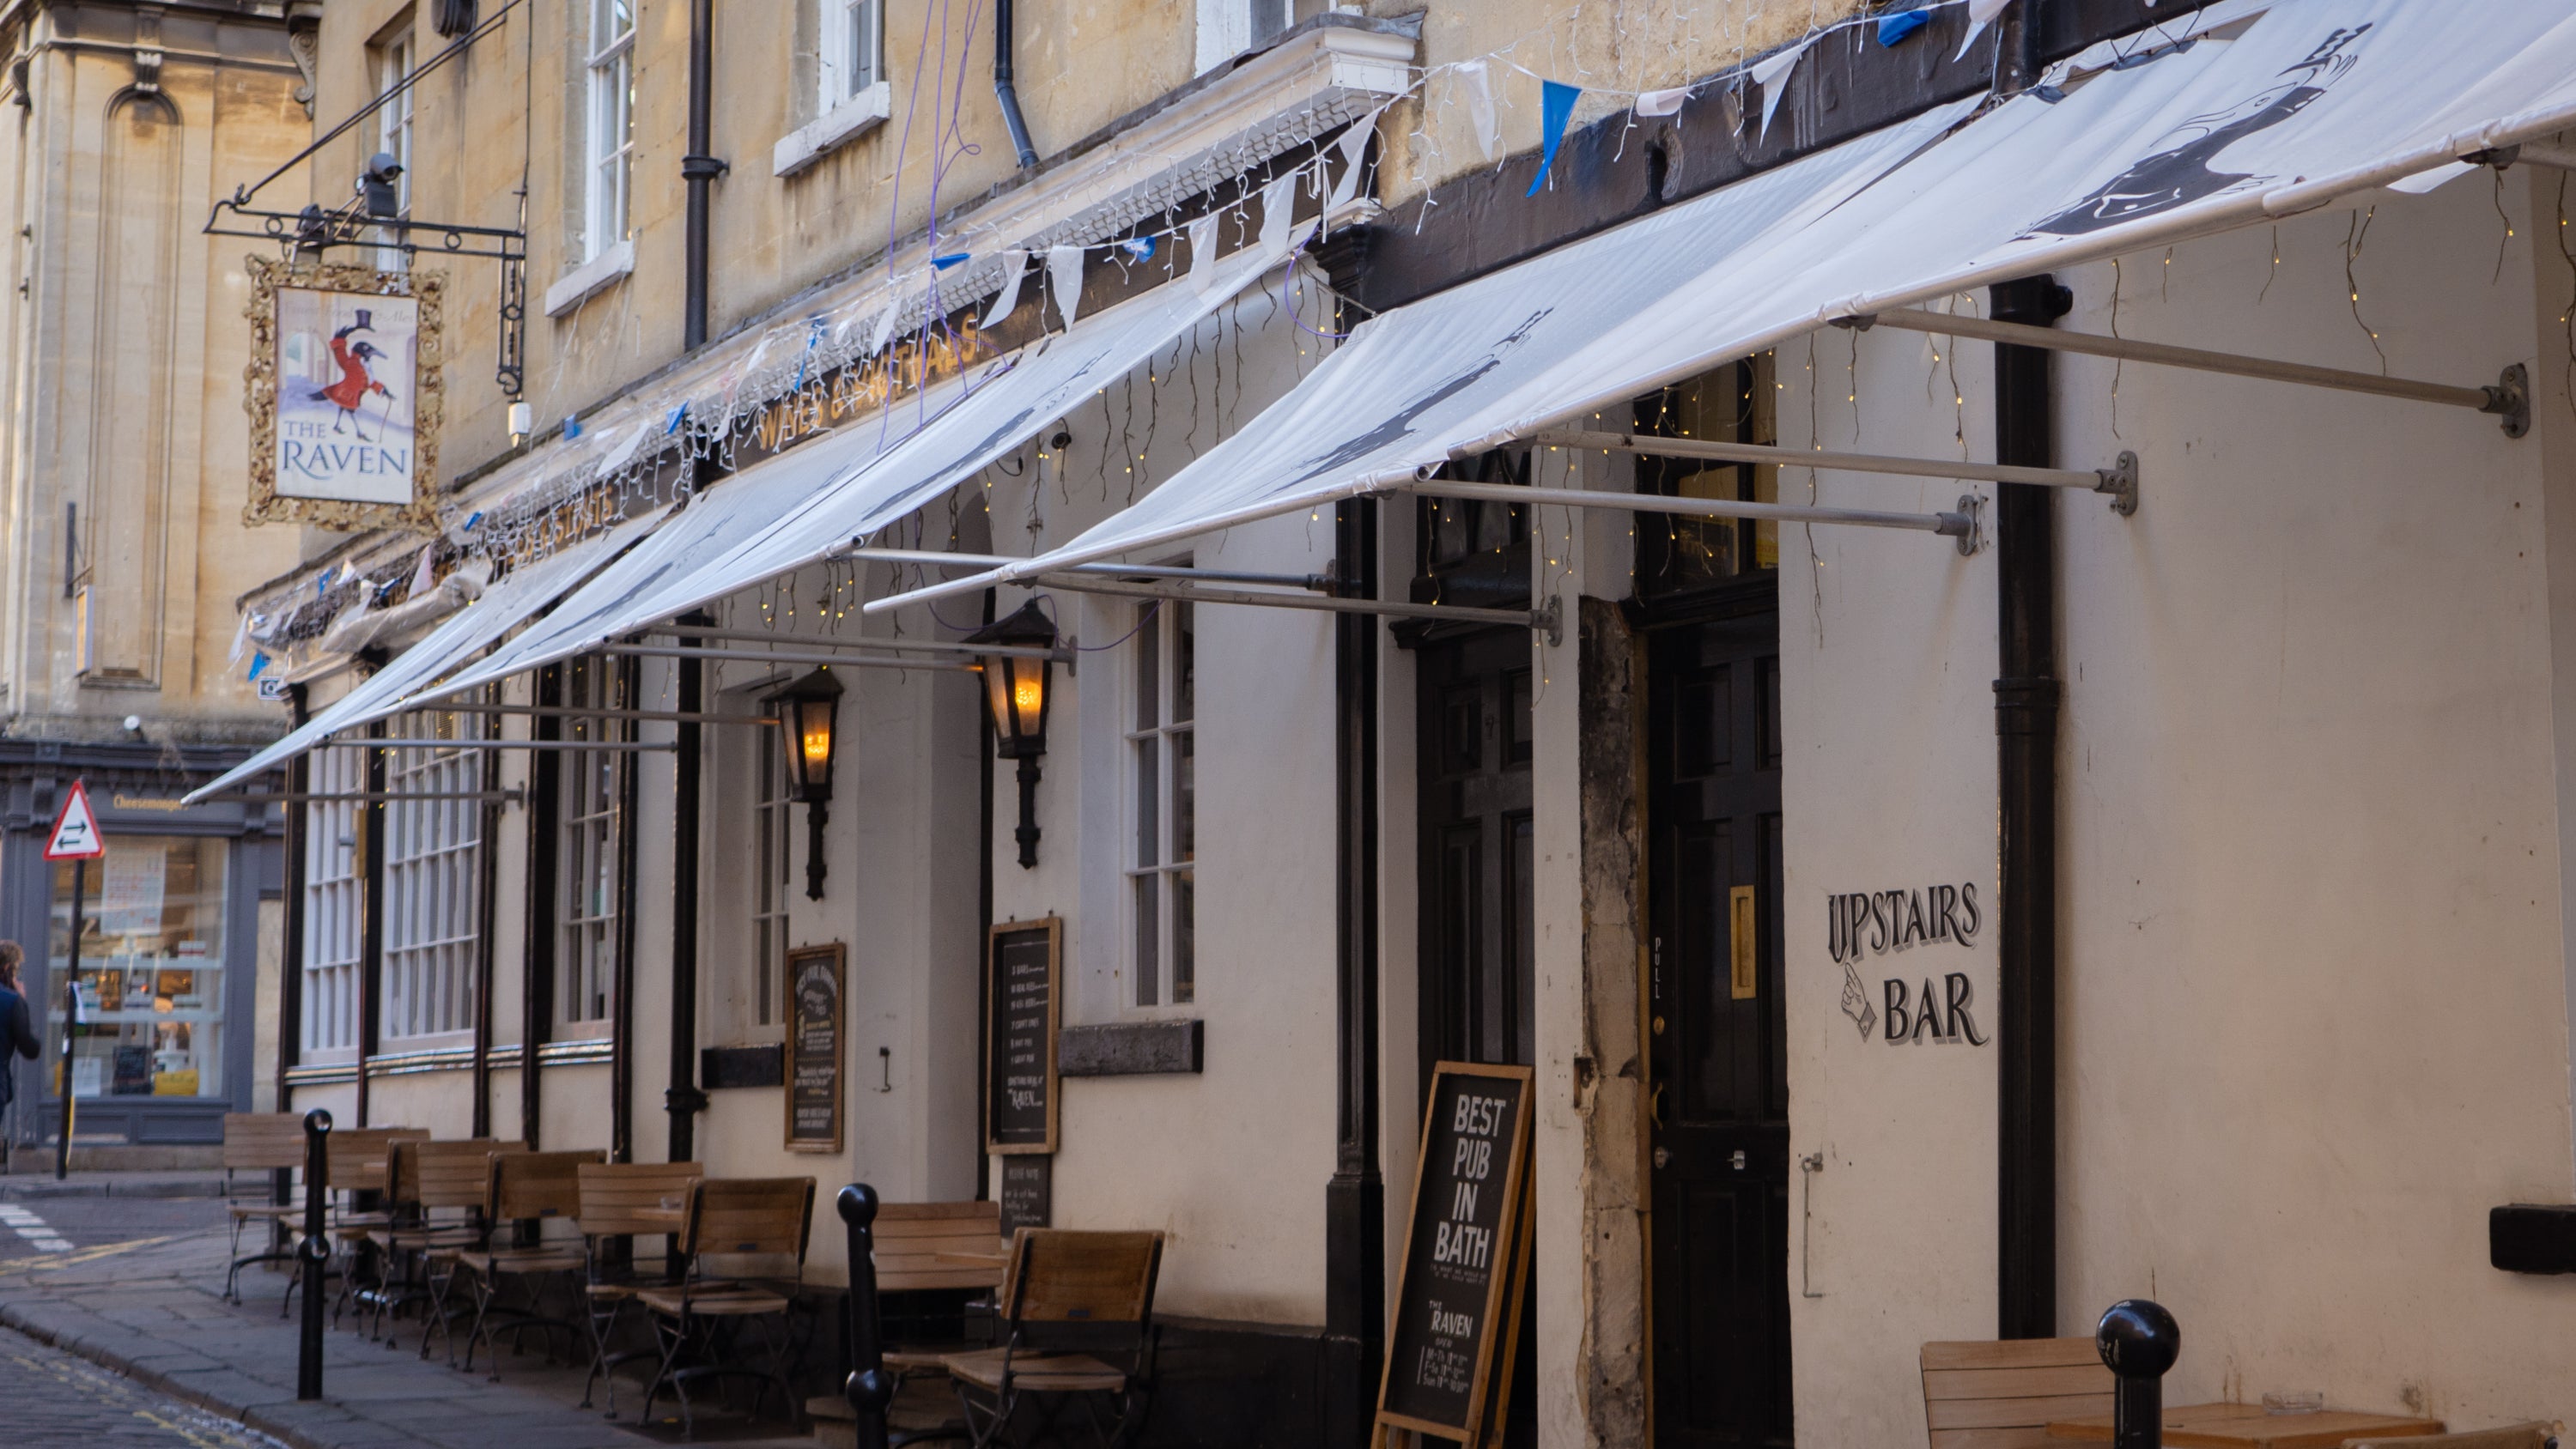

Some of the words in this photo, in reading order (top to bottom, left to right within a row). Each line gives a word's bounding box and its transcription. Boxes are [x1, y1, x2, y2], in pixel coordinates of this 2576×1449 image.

[284, 421, 326, 439] THE
[283, 440, 406, 481] RAVEN
[1828, 882, 1981, 964] UPSTAIRS
[1884, 973, 1990, 1047] BAR
[1454, 1094, 1505, 1137] BEST
[1453, 1138, 1490, 1179] PUB
[1452, 1183, 1477, 1222] IN
[1434, 1222, 1490, 1269] BATH
[1429, 1300, 1443, 1311] THE
[1431, 1310, 1473, 1338] RAVEN
